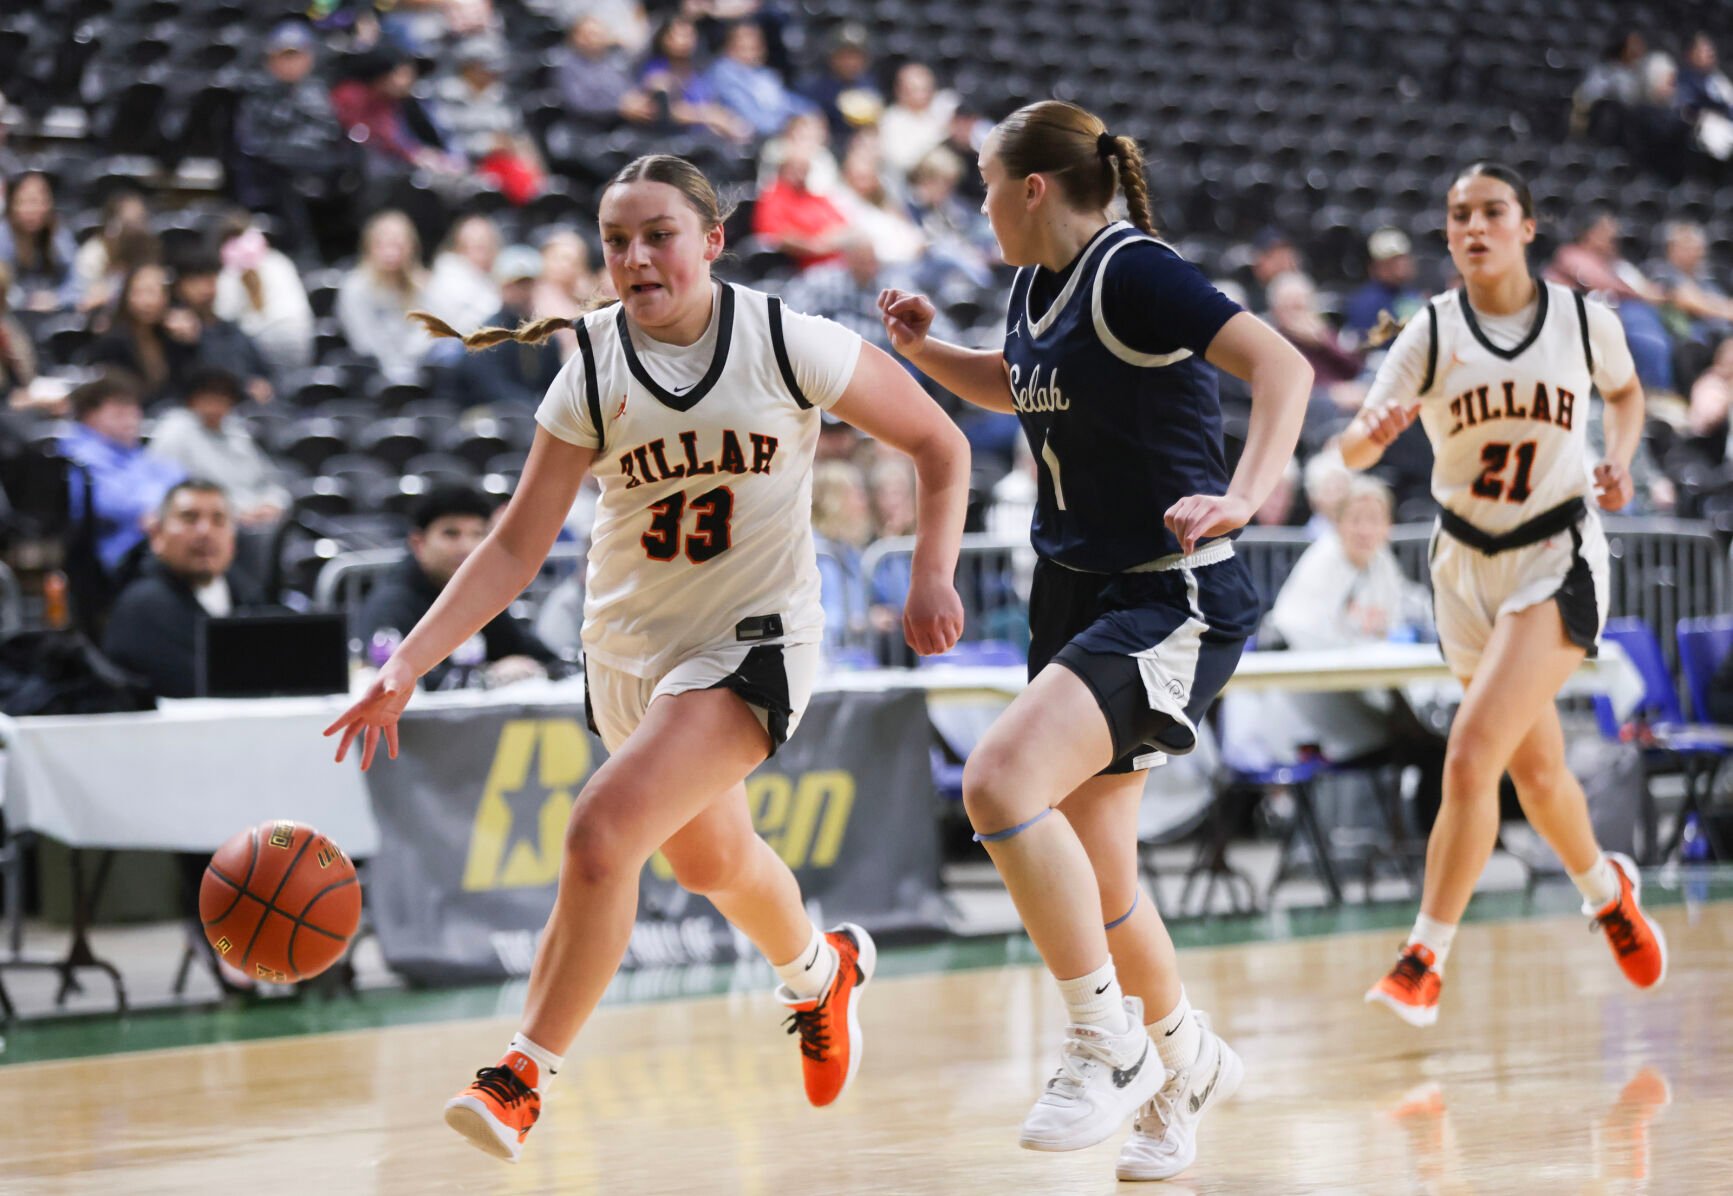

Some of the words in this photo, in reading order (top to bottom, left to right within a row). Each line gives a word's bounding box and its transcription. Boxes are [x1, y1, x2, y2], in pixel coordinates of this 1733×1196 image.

[1009, 363, 1070, 414] Selah
[1449, 380, 1575, 437] ZILLAH
[619, 429, 779, 489] ZILLAH
[1041, 427, 1067, 511] 1
[1471, 440, 1537, 505] 21
[640, 485, 735, 565] 33
